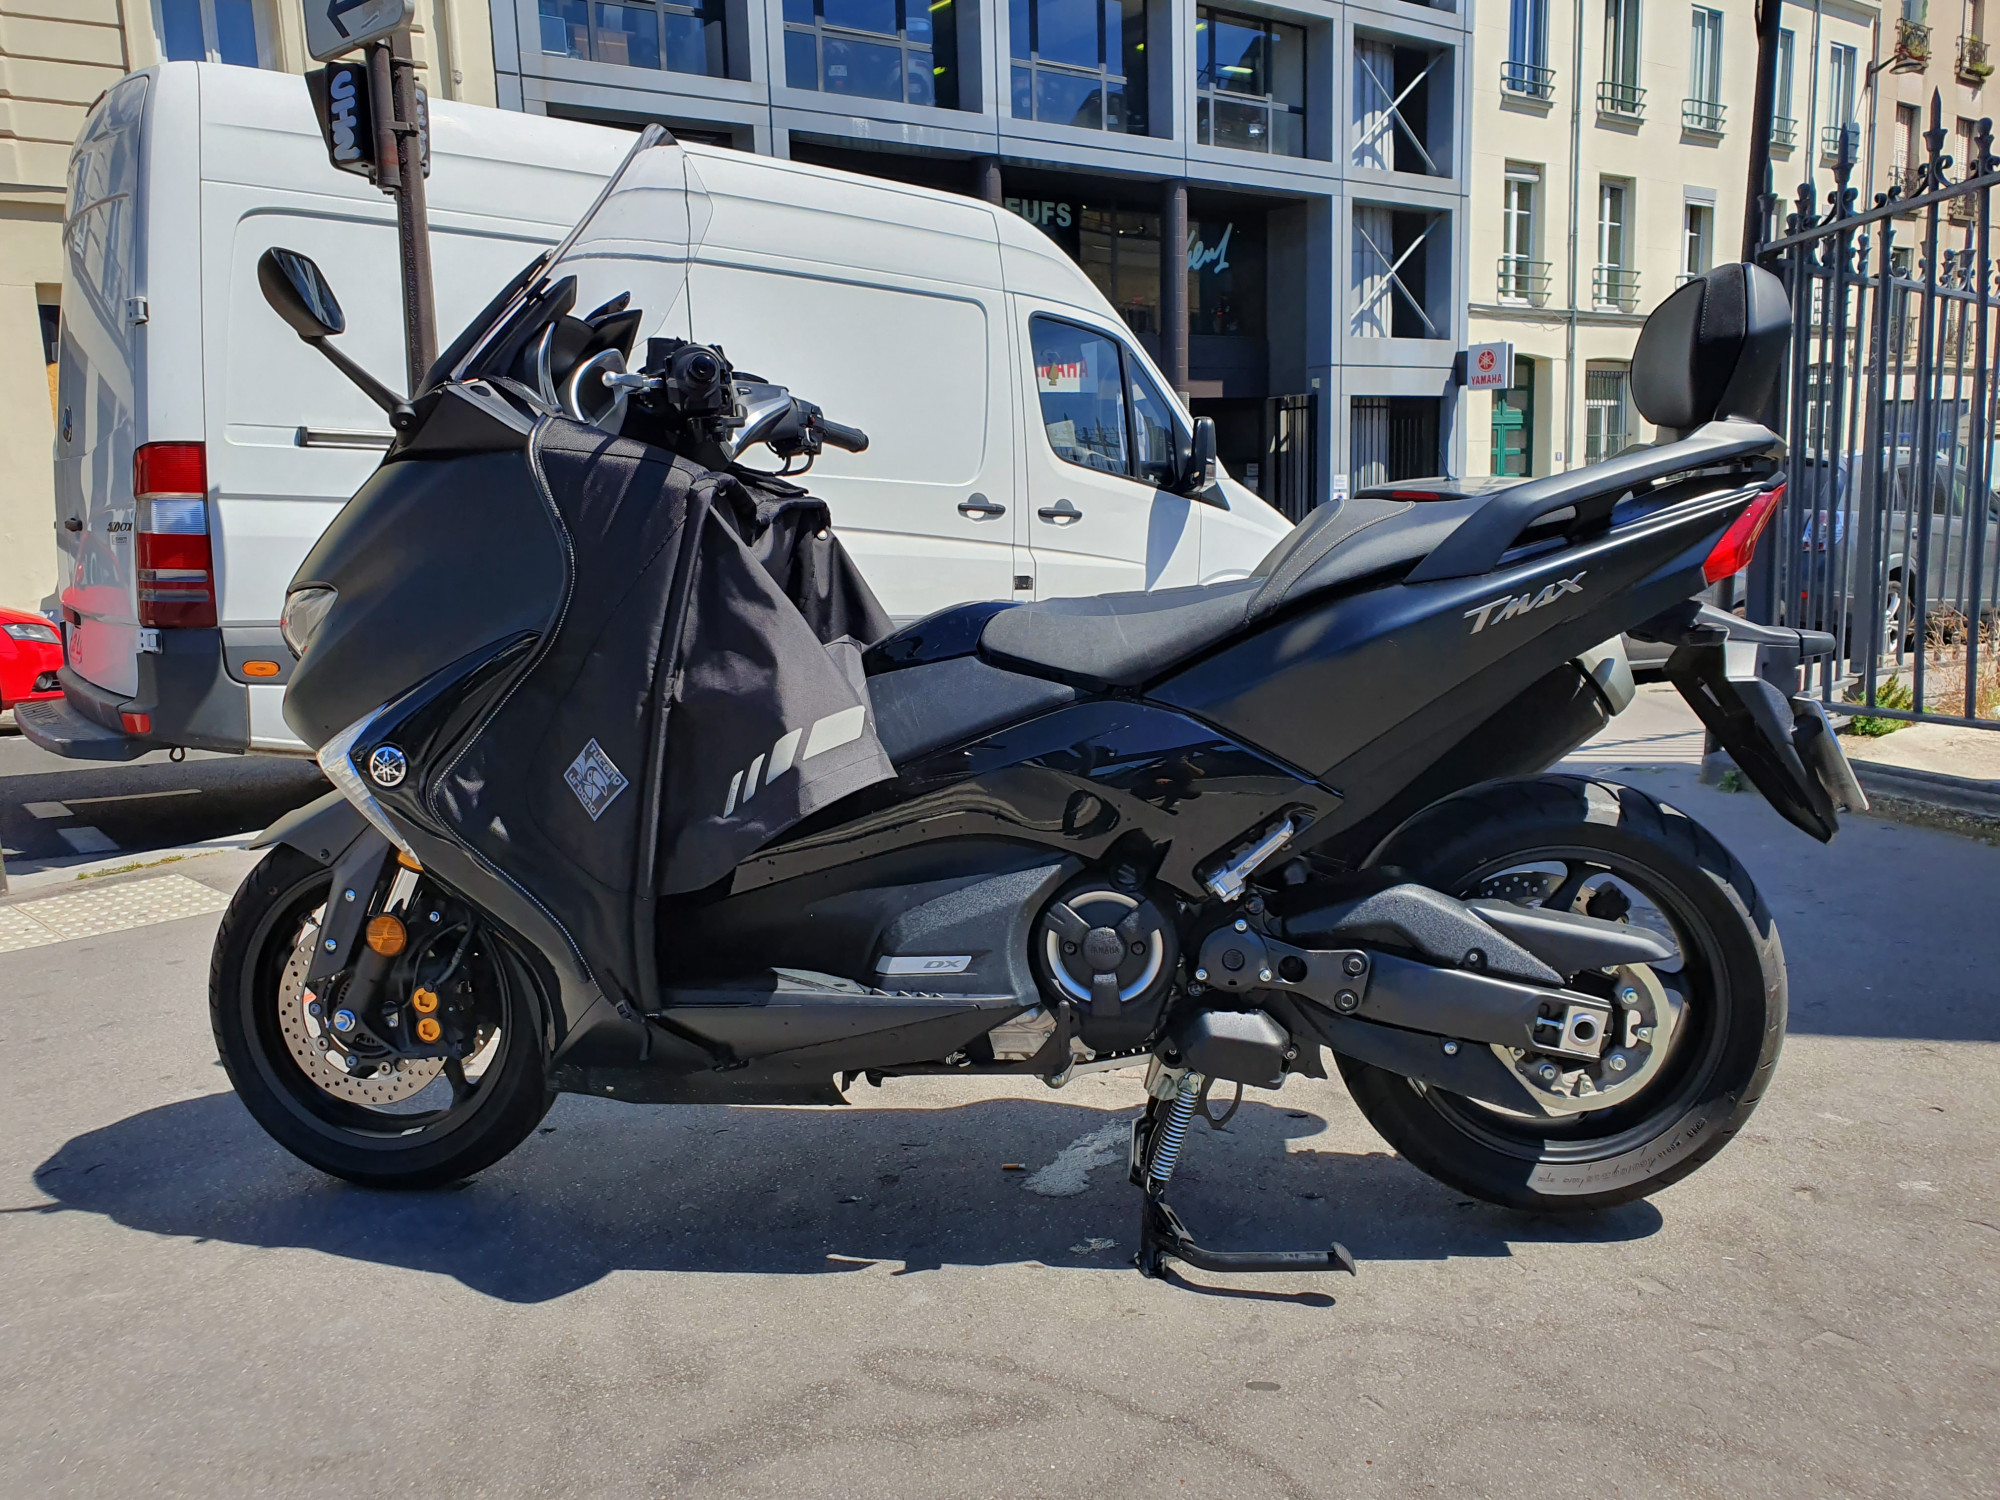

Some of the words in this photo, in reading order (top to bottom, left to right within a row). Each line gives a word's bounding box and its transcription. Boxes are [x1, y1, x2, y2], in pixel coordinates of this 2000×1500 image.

[1471, 374, 1502, 385] YAMAHA
[1463, 571, 1587, 635] TMAX
[923, 960, 960, 969] DX
